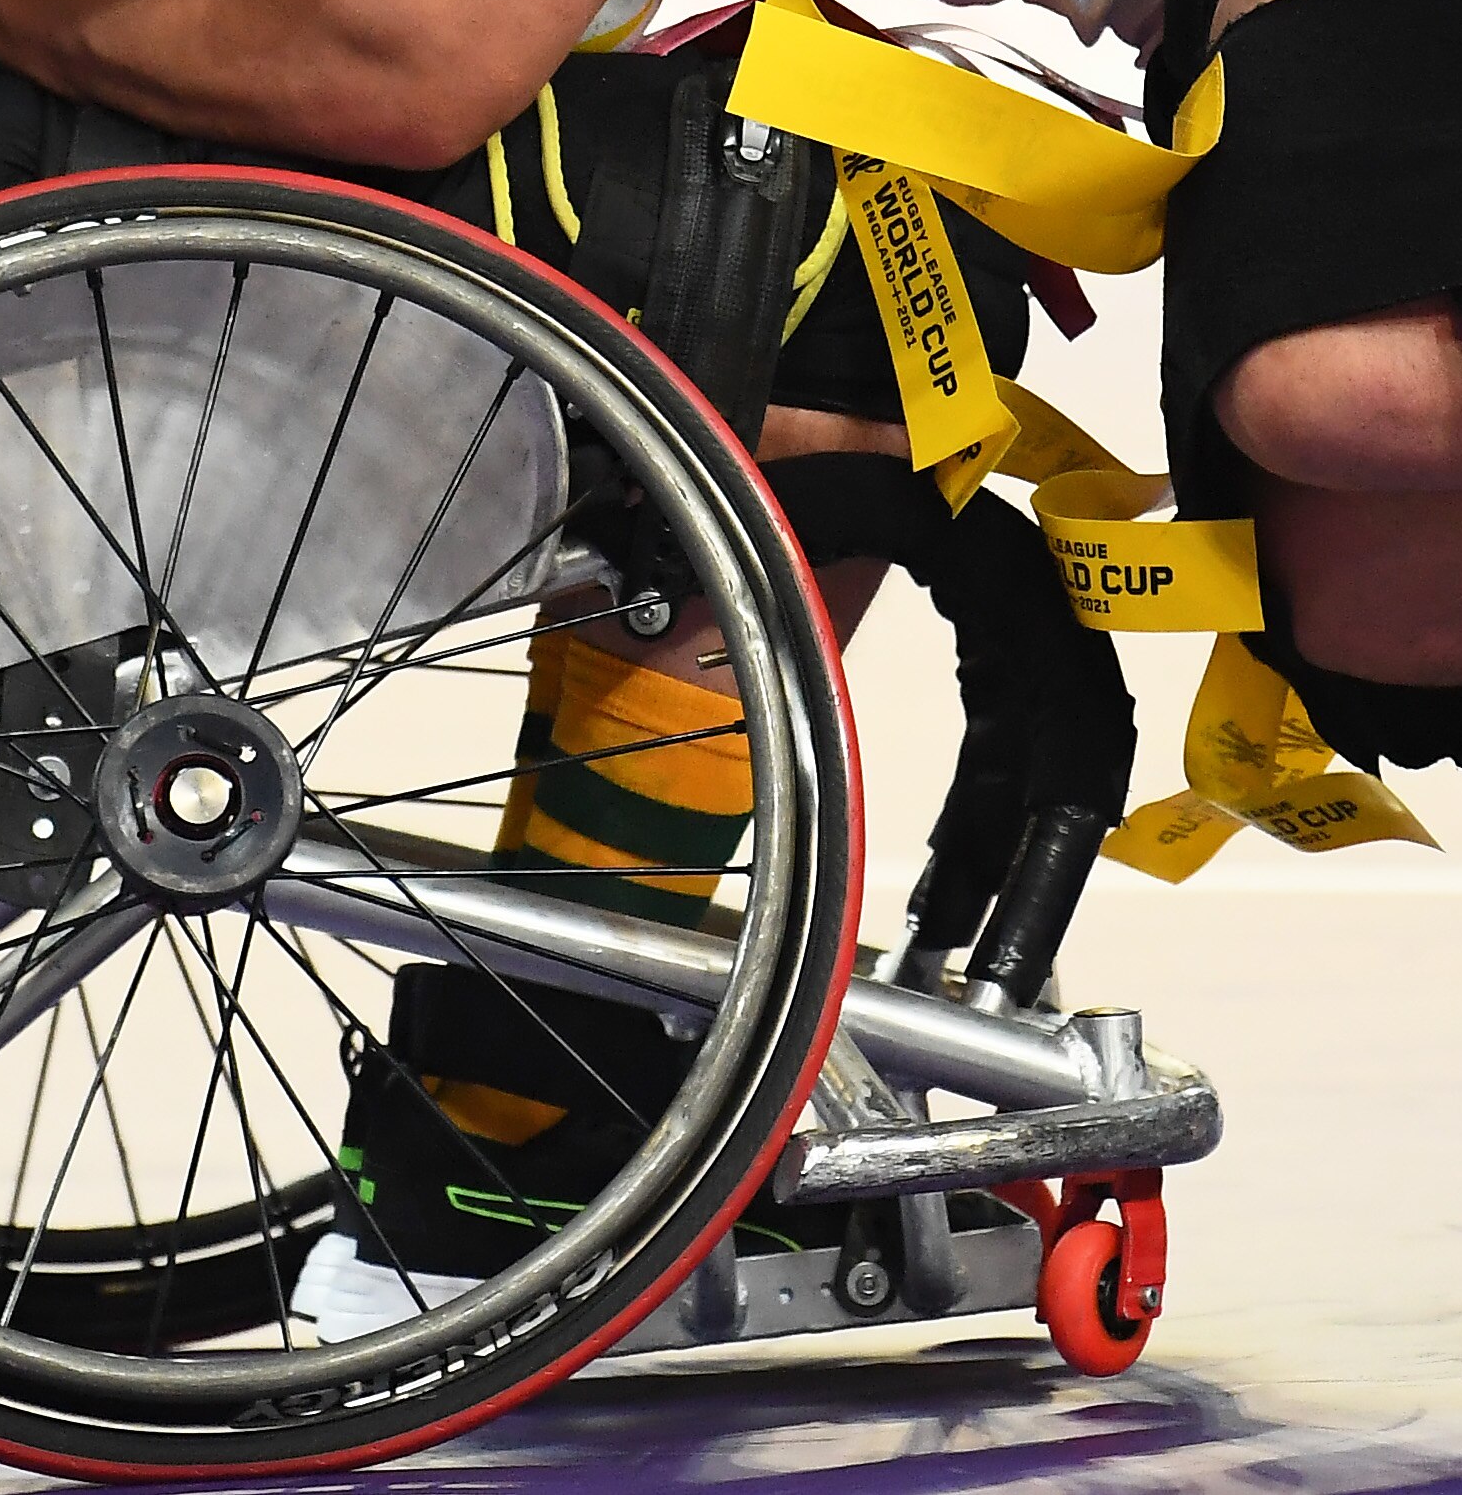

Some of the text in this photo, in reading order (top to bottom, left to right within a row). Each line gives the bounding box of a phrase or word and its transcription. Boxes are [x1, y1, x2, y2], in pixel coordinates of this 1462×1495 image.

[861, 199, 918, 350] ENGLAND 2021
[874, 181, 959, 397] WORLD CUP
[896, 175, 958, 327] RUGBY LEAGUE
[1100, 565, 1174, 596] CUP
[1298, 799, 1359, 836] CUP
